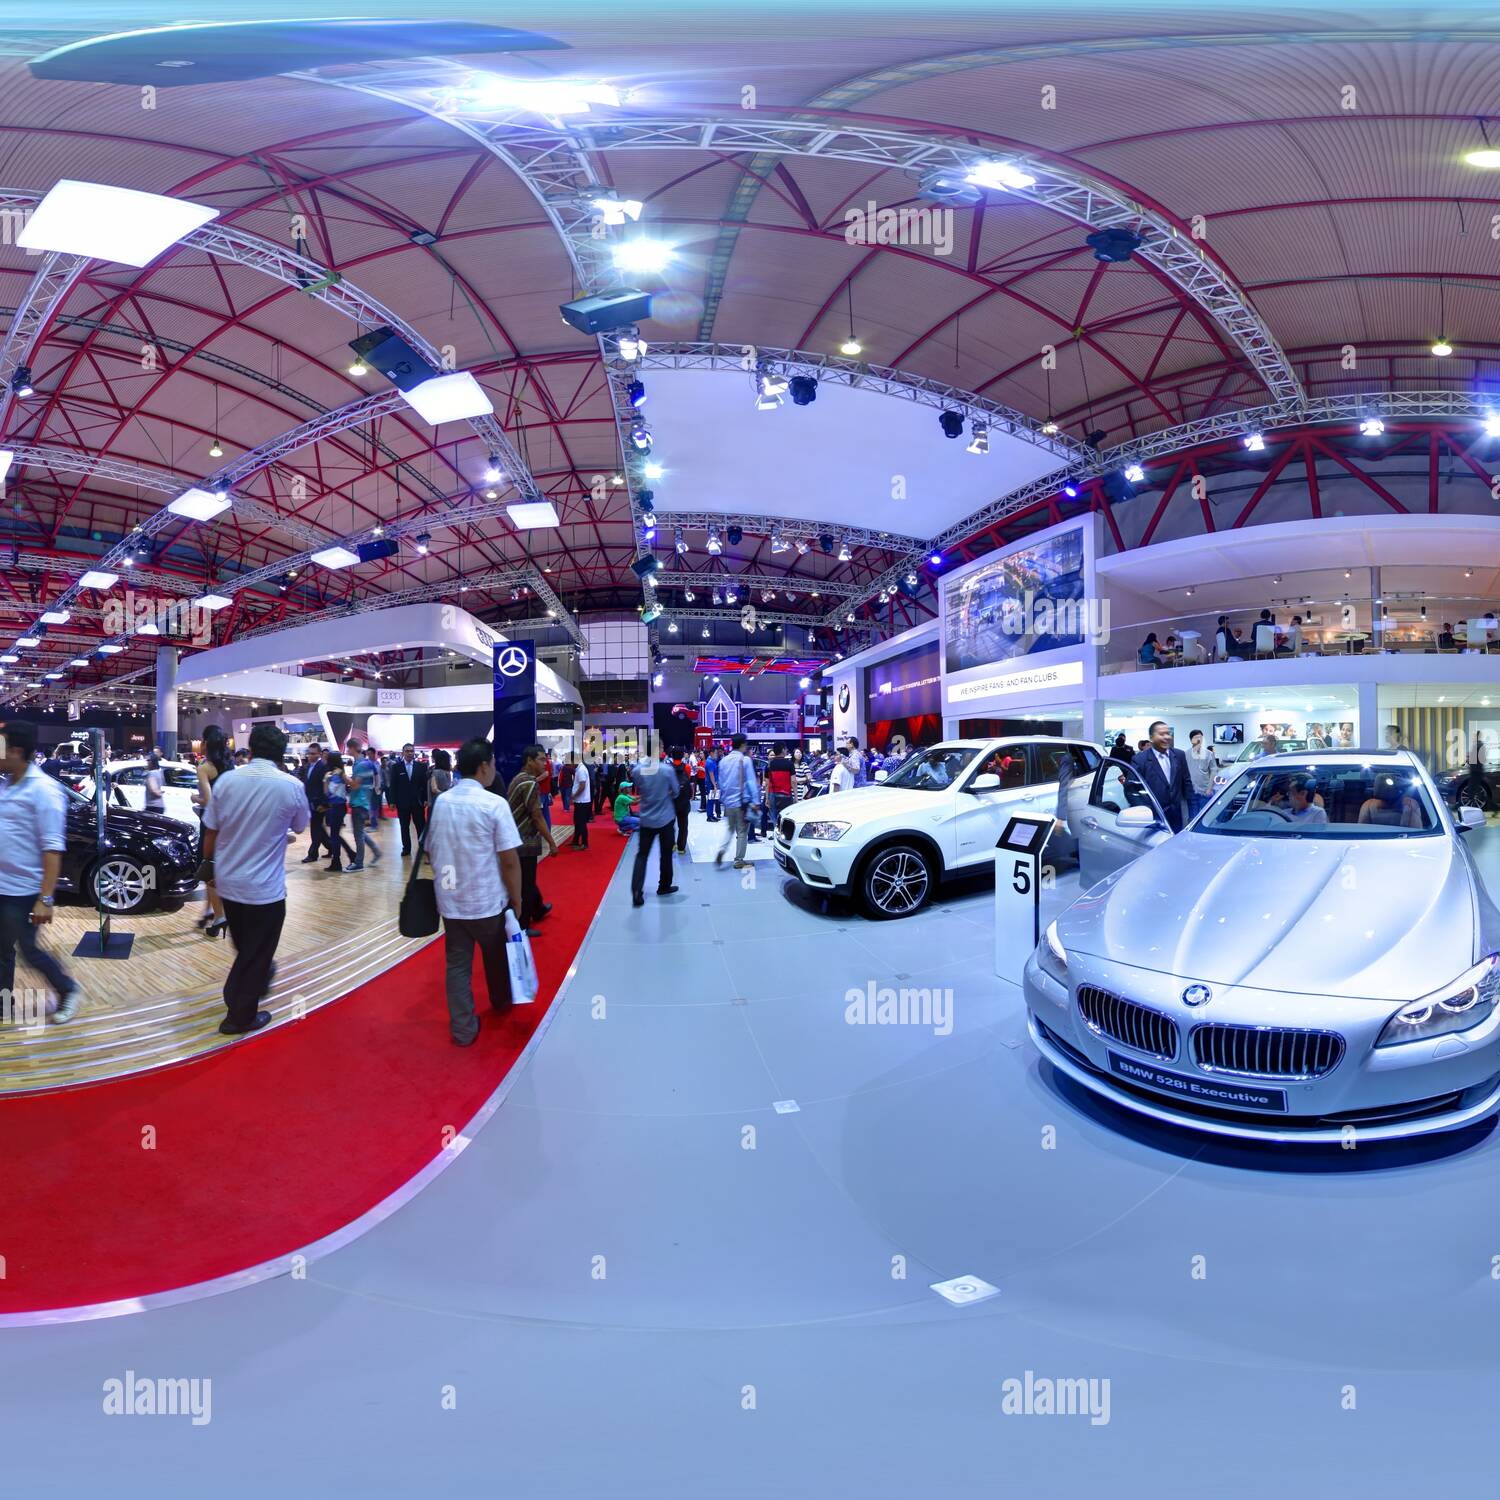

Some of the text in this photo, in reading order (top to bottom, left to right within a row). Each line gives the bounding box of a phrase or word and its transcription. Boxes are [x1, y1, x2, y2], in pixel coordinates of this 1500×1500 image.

[1006, 678, 1019, 687] AND
[1020, 675, 1033, 685] FAN
[1013, 860, 1030, 894] 5
[1119, 1061, 1269, 1105] BMW 528i Executive
